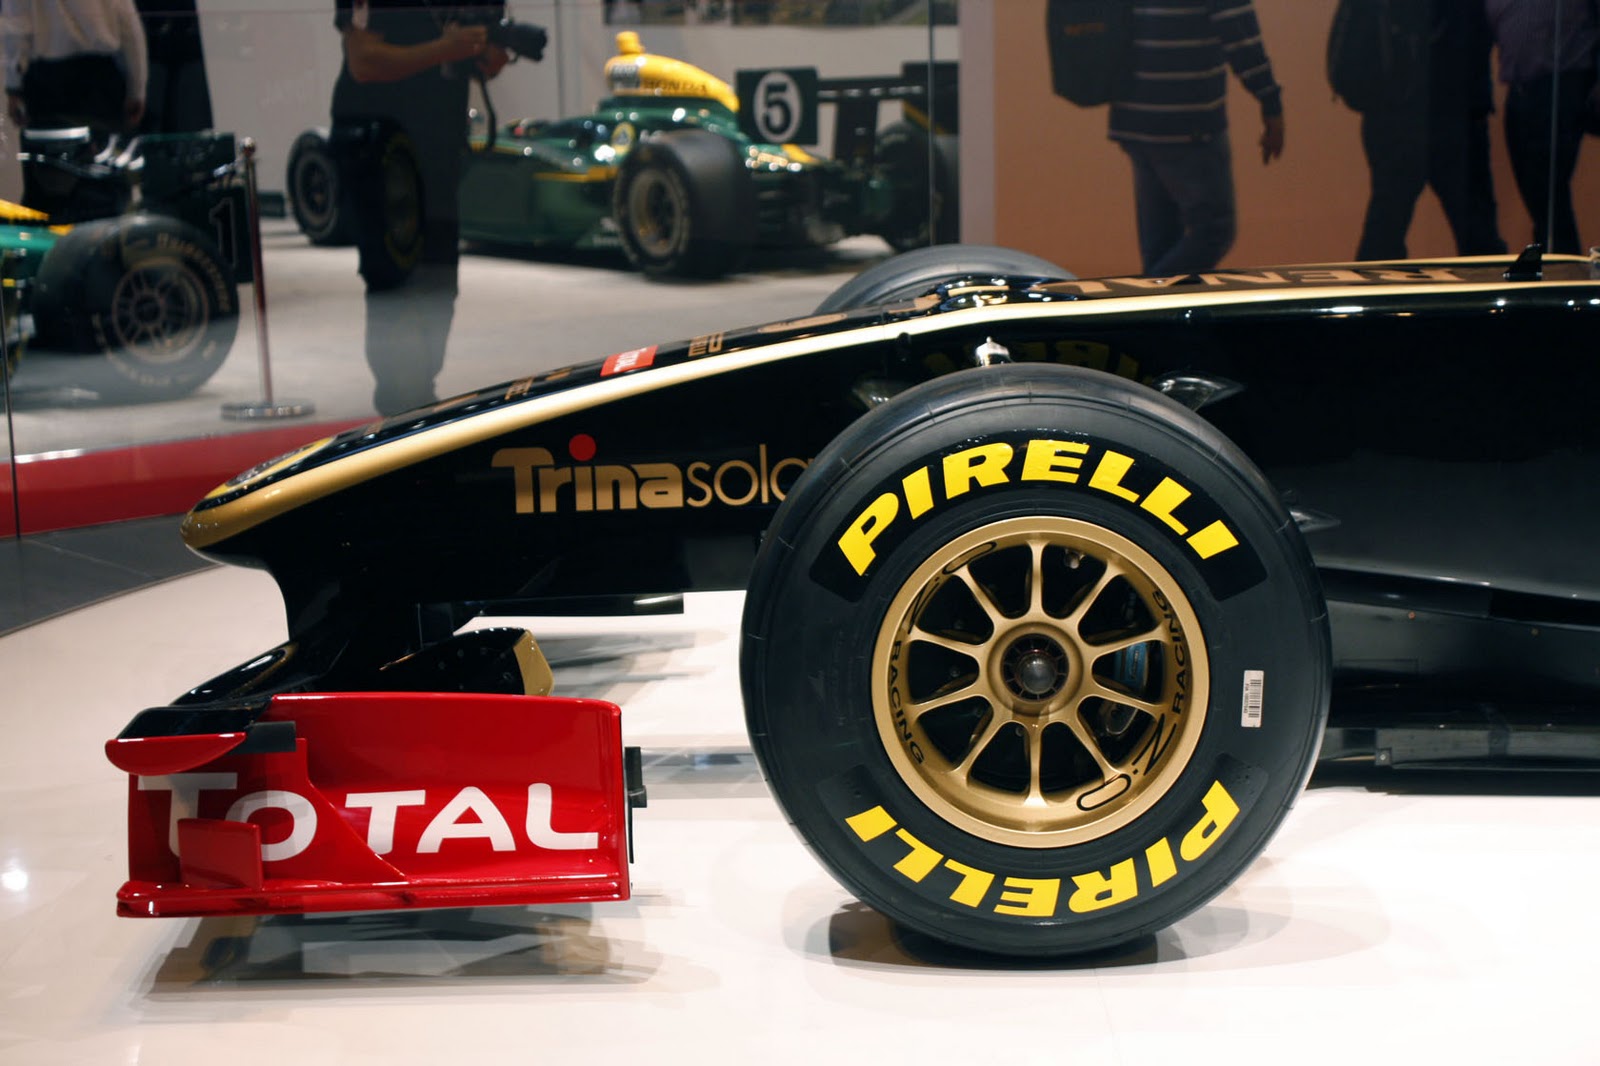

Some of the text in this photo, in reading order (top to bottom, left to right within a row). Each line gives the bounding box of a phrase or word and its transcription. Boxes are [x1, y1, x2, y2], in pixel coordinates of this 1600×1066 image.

[643, 79, 708, 95] HONDA
[763, 82, 792, 135] 5
[491, 433, 815, 514] Trinasola
[837, 439, 1240, 577] PIRELLI
[888, 639, 925, 765] RACING
[1152, 587, 1187, 715] RACING
[137, 771, 600, 861] TOTAL
[844, 780, 1241, 917] PIRELLI
